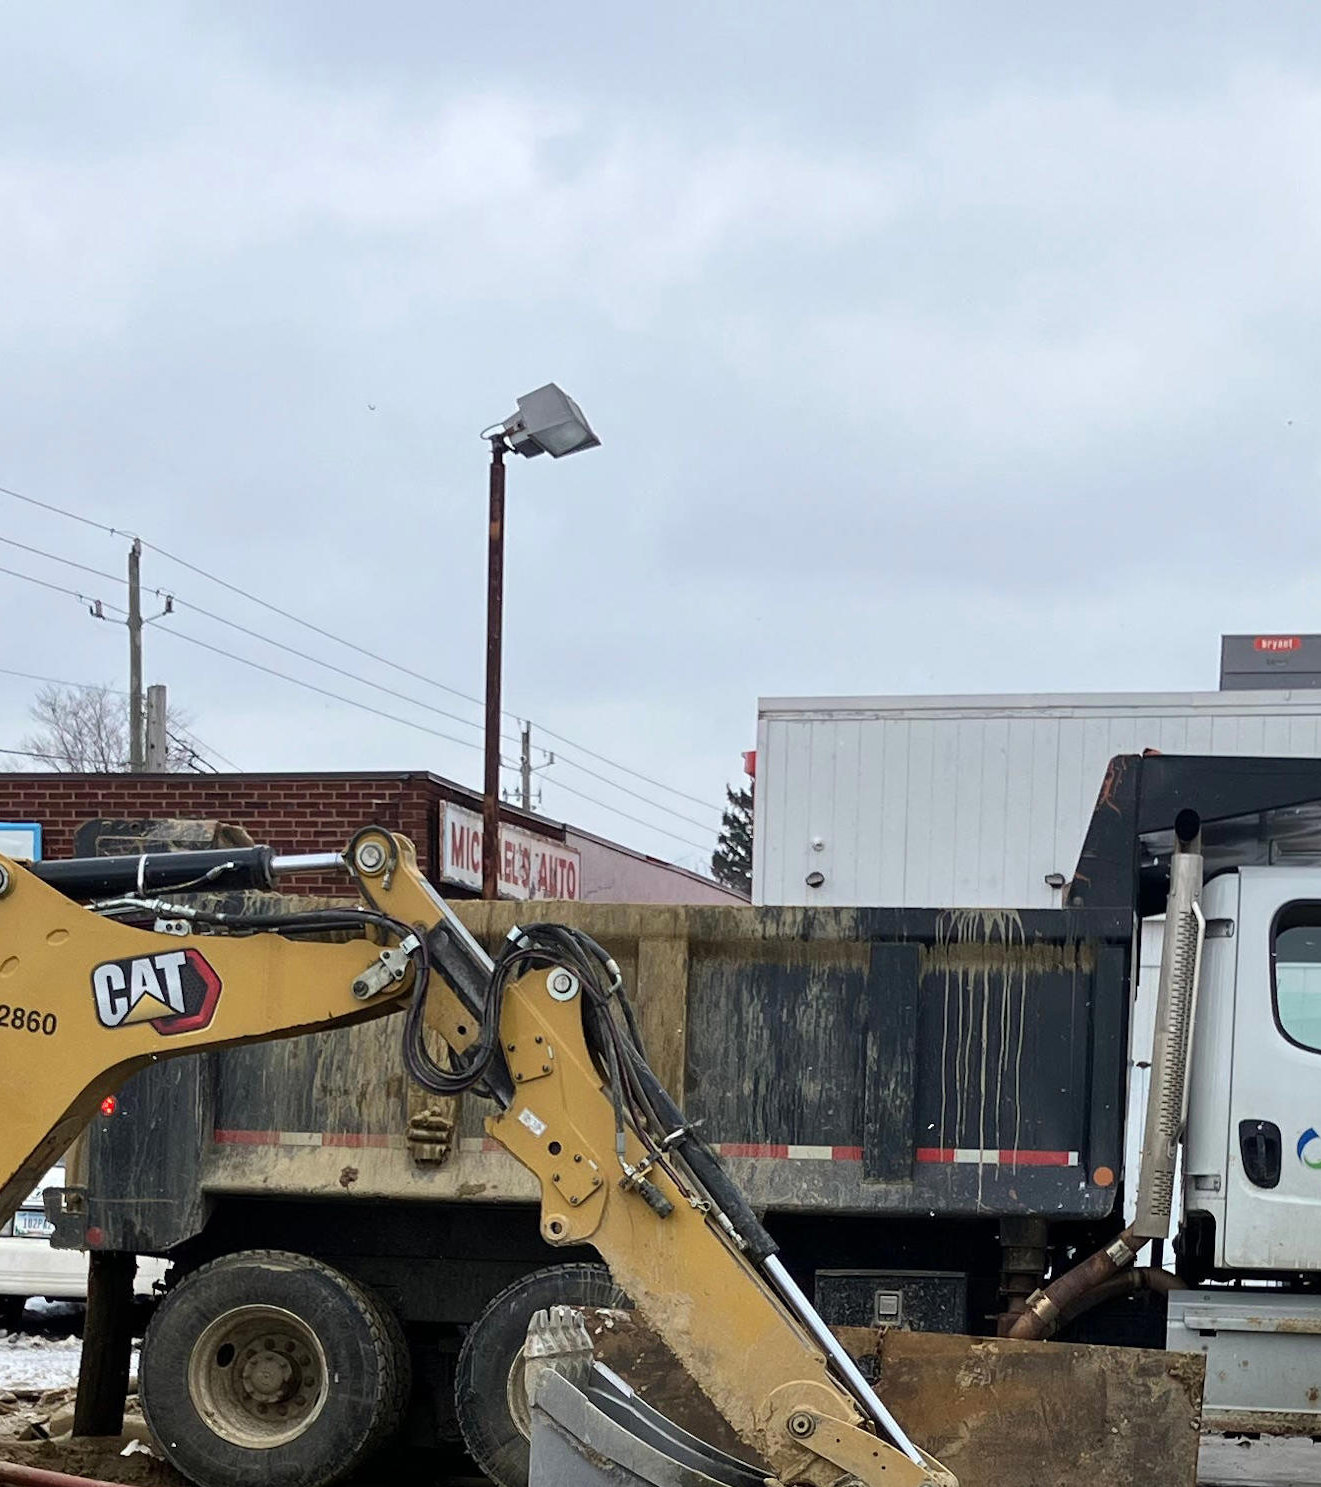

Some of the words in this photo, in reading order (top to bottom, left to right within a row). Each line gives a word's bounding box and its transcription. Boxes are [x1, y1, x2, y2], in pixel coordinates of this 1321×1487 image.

[1260, 638, 1294, 650] bryant
[538, 852, 576, 900] AUTO
[93, 950, 187, 1026] CAT
